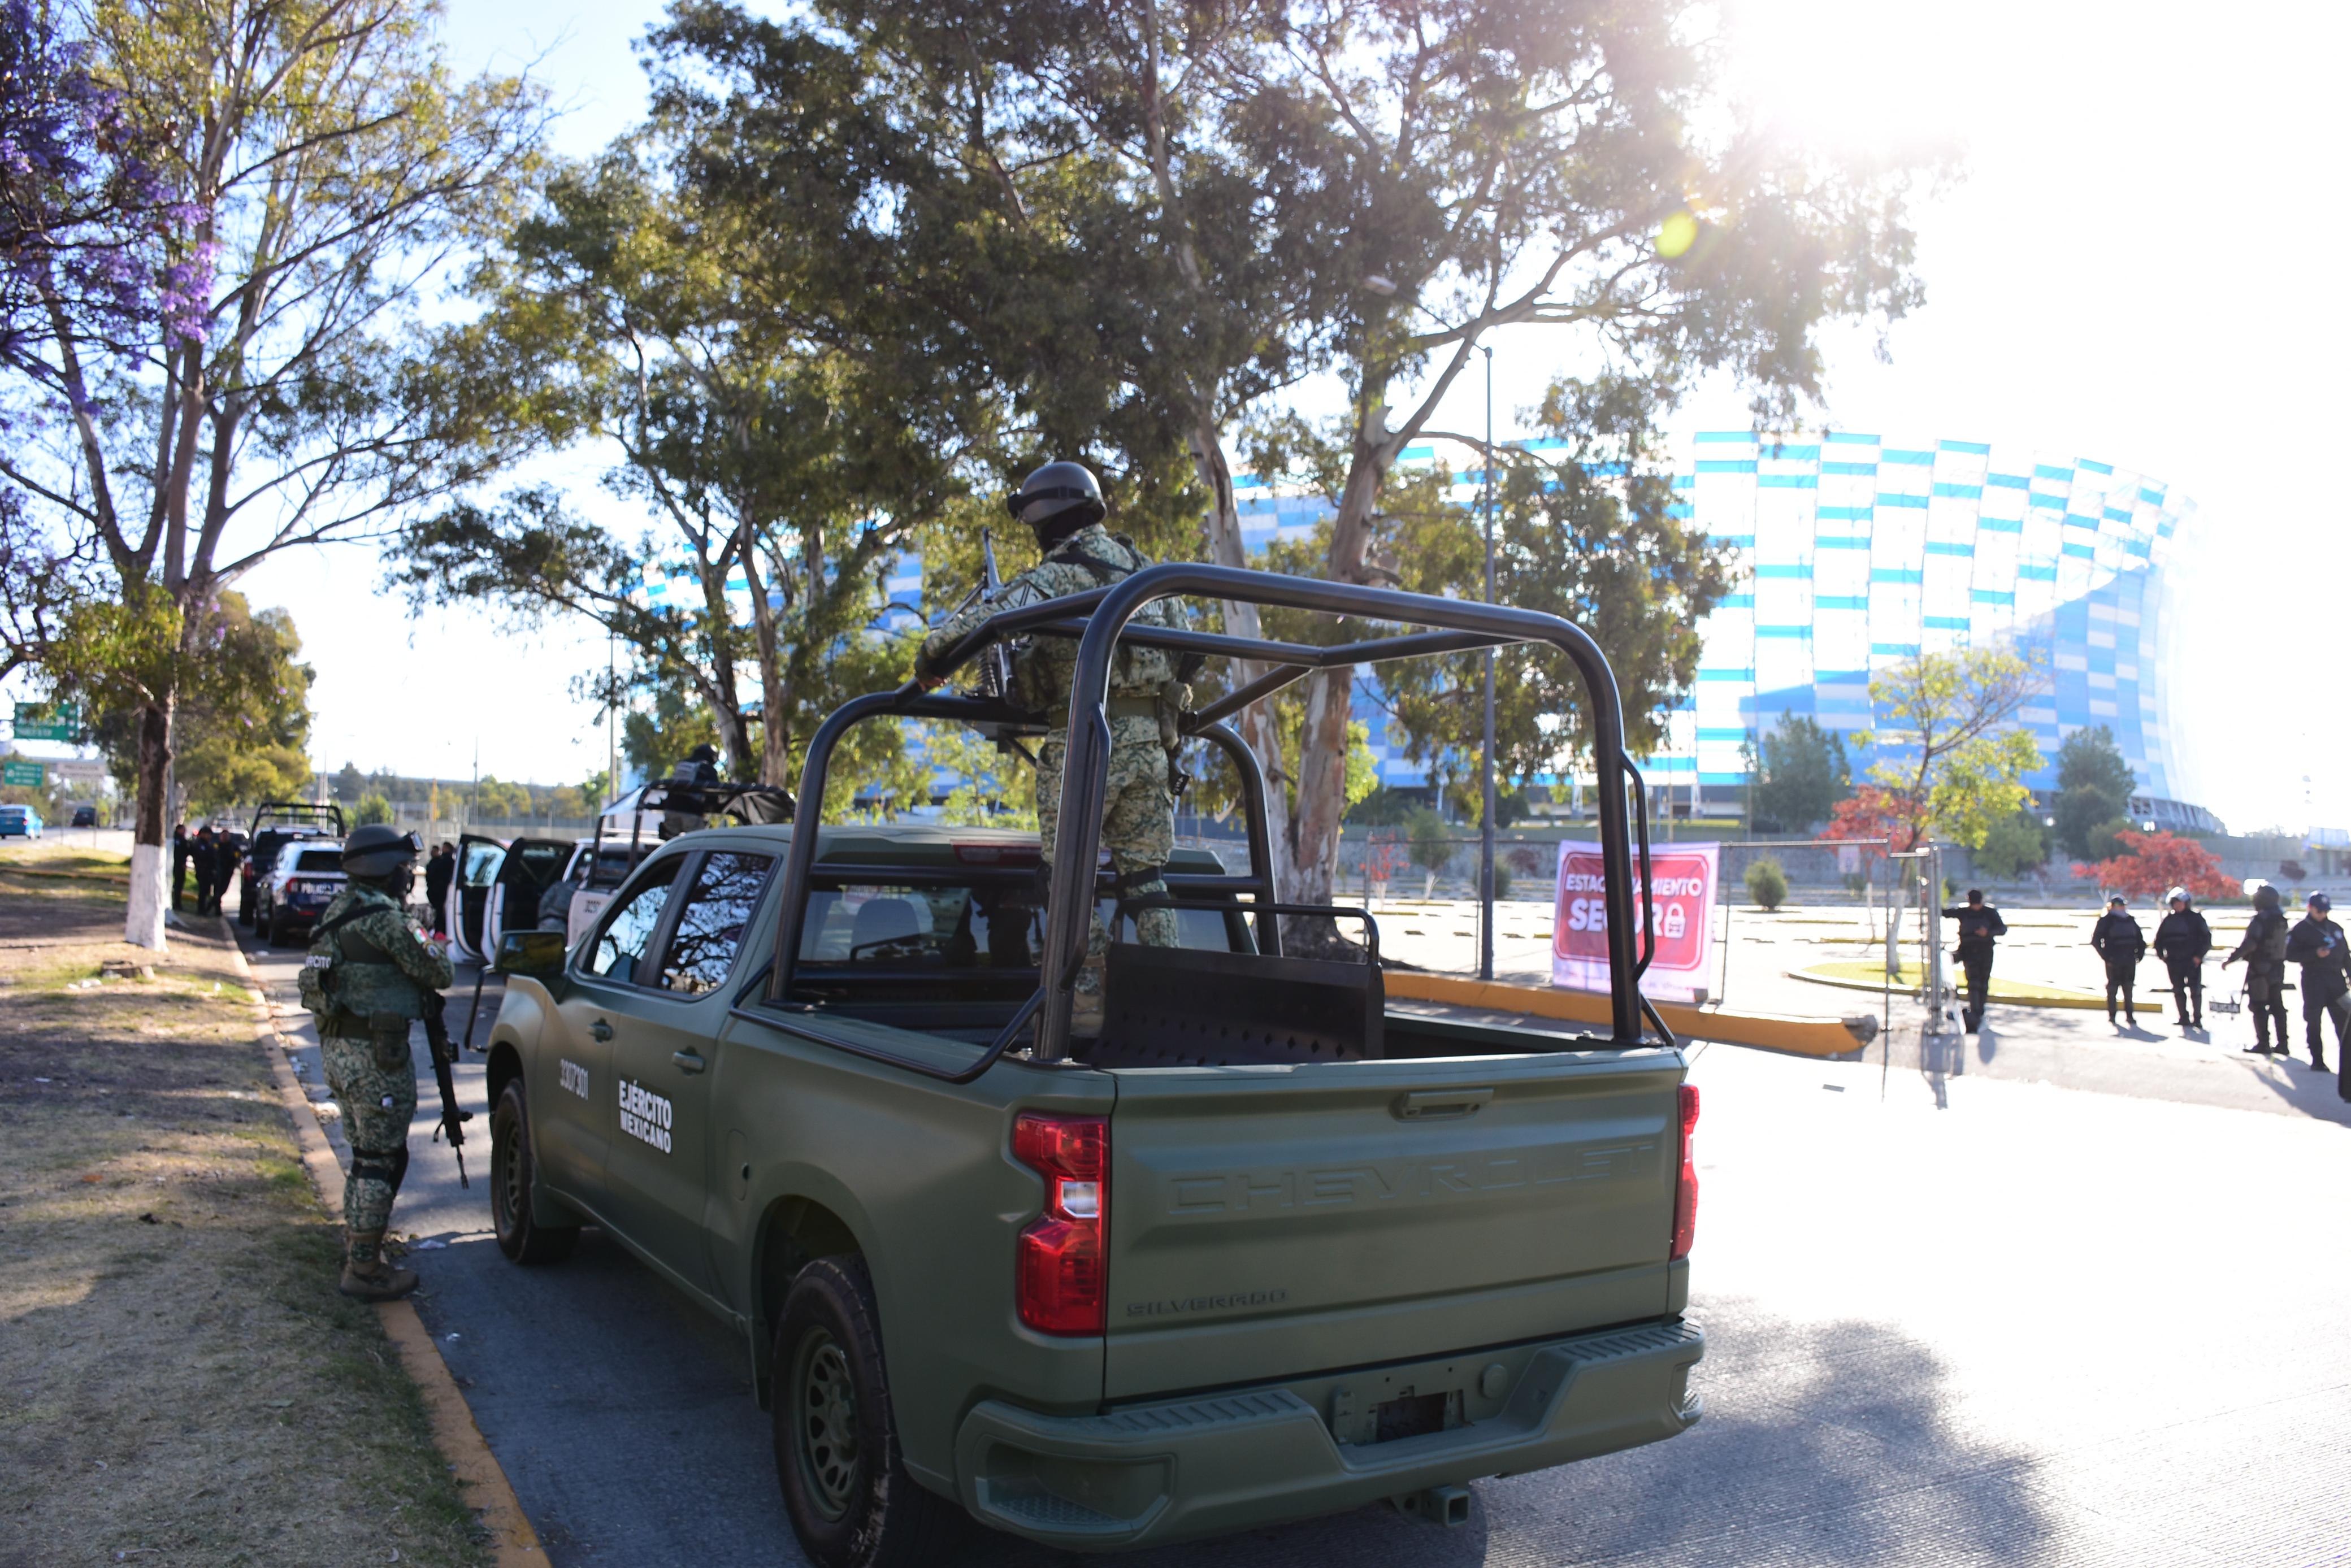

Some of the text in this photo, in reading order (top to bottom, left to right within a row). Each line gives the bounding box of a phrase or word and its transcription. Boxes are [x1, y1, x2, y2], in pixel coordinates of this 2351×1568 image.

[619, 1079, 673, 1130] EJÉRCITO
[620, 1109, 672, 1154] MEXICANO
[1169, 1140, 1655, 1215] CHEVROLET
[1126, 1289, 1290, 1317] SILVERADO
